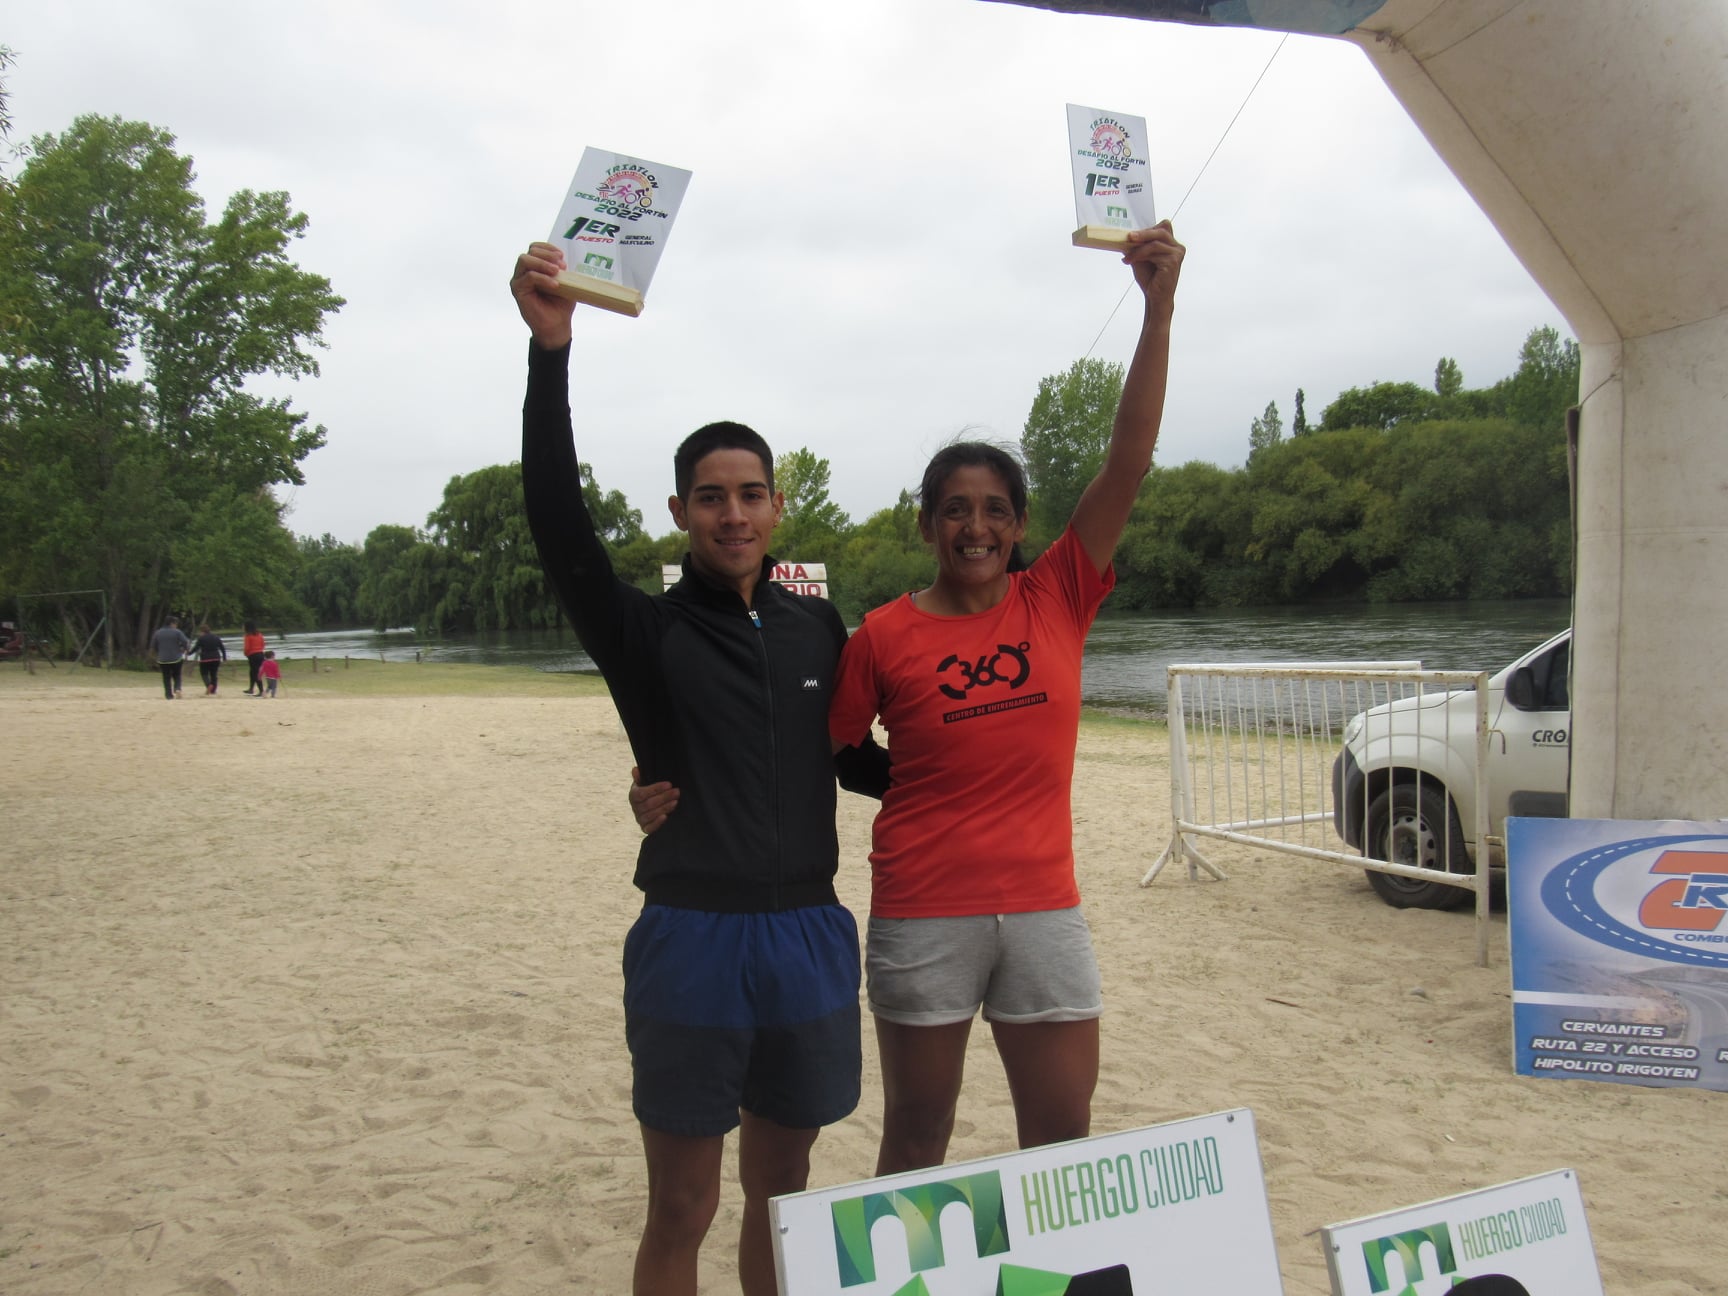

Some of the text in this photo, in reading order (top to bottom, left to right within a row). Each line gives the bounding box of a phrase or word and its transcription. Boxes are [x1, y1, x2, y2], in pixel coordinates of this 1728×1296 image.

[1090, 117, 1130, 139] TRIATLON
[1095, 158, 1130, 171] 2022
[605, 164, 659, 189] TRIATLON
[1085, 173, 1120, 196] 1ER
[594, 204, 642, 221] 2022
[563, 217, 620, 239] 1ER
[946, 694, 1045, 721] CENTRO DE ENTRENAMIENTO
[1532, 729, 1569, 743] CRO
[1561, 1021, 1665, 1038] CERVANTES
[1531, 1038, 1697, 1059] RUTA 22 Y ACCESO
[1534, 1058, 1698, 1078] HIPOLITO IRIGOYEN
[1020, 1136, 1224, 1236] HUERGO CIUDAD
[1458, 1197, 1567, 1261] HUERGO CIUDAD
